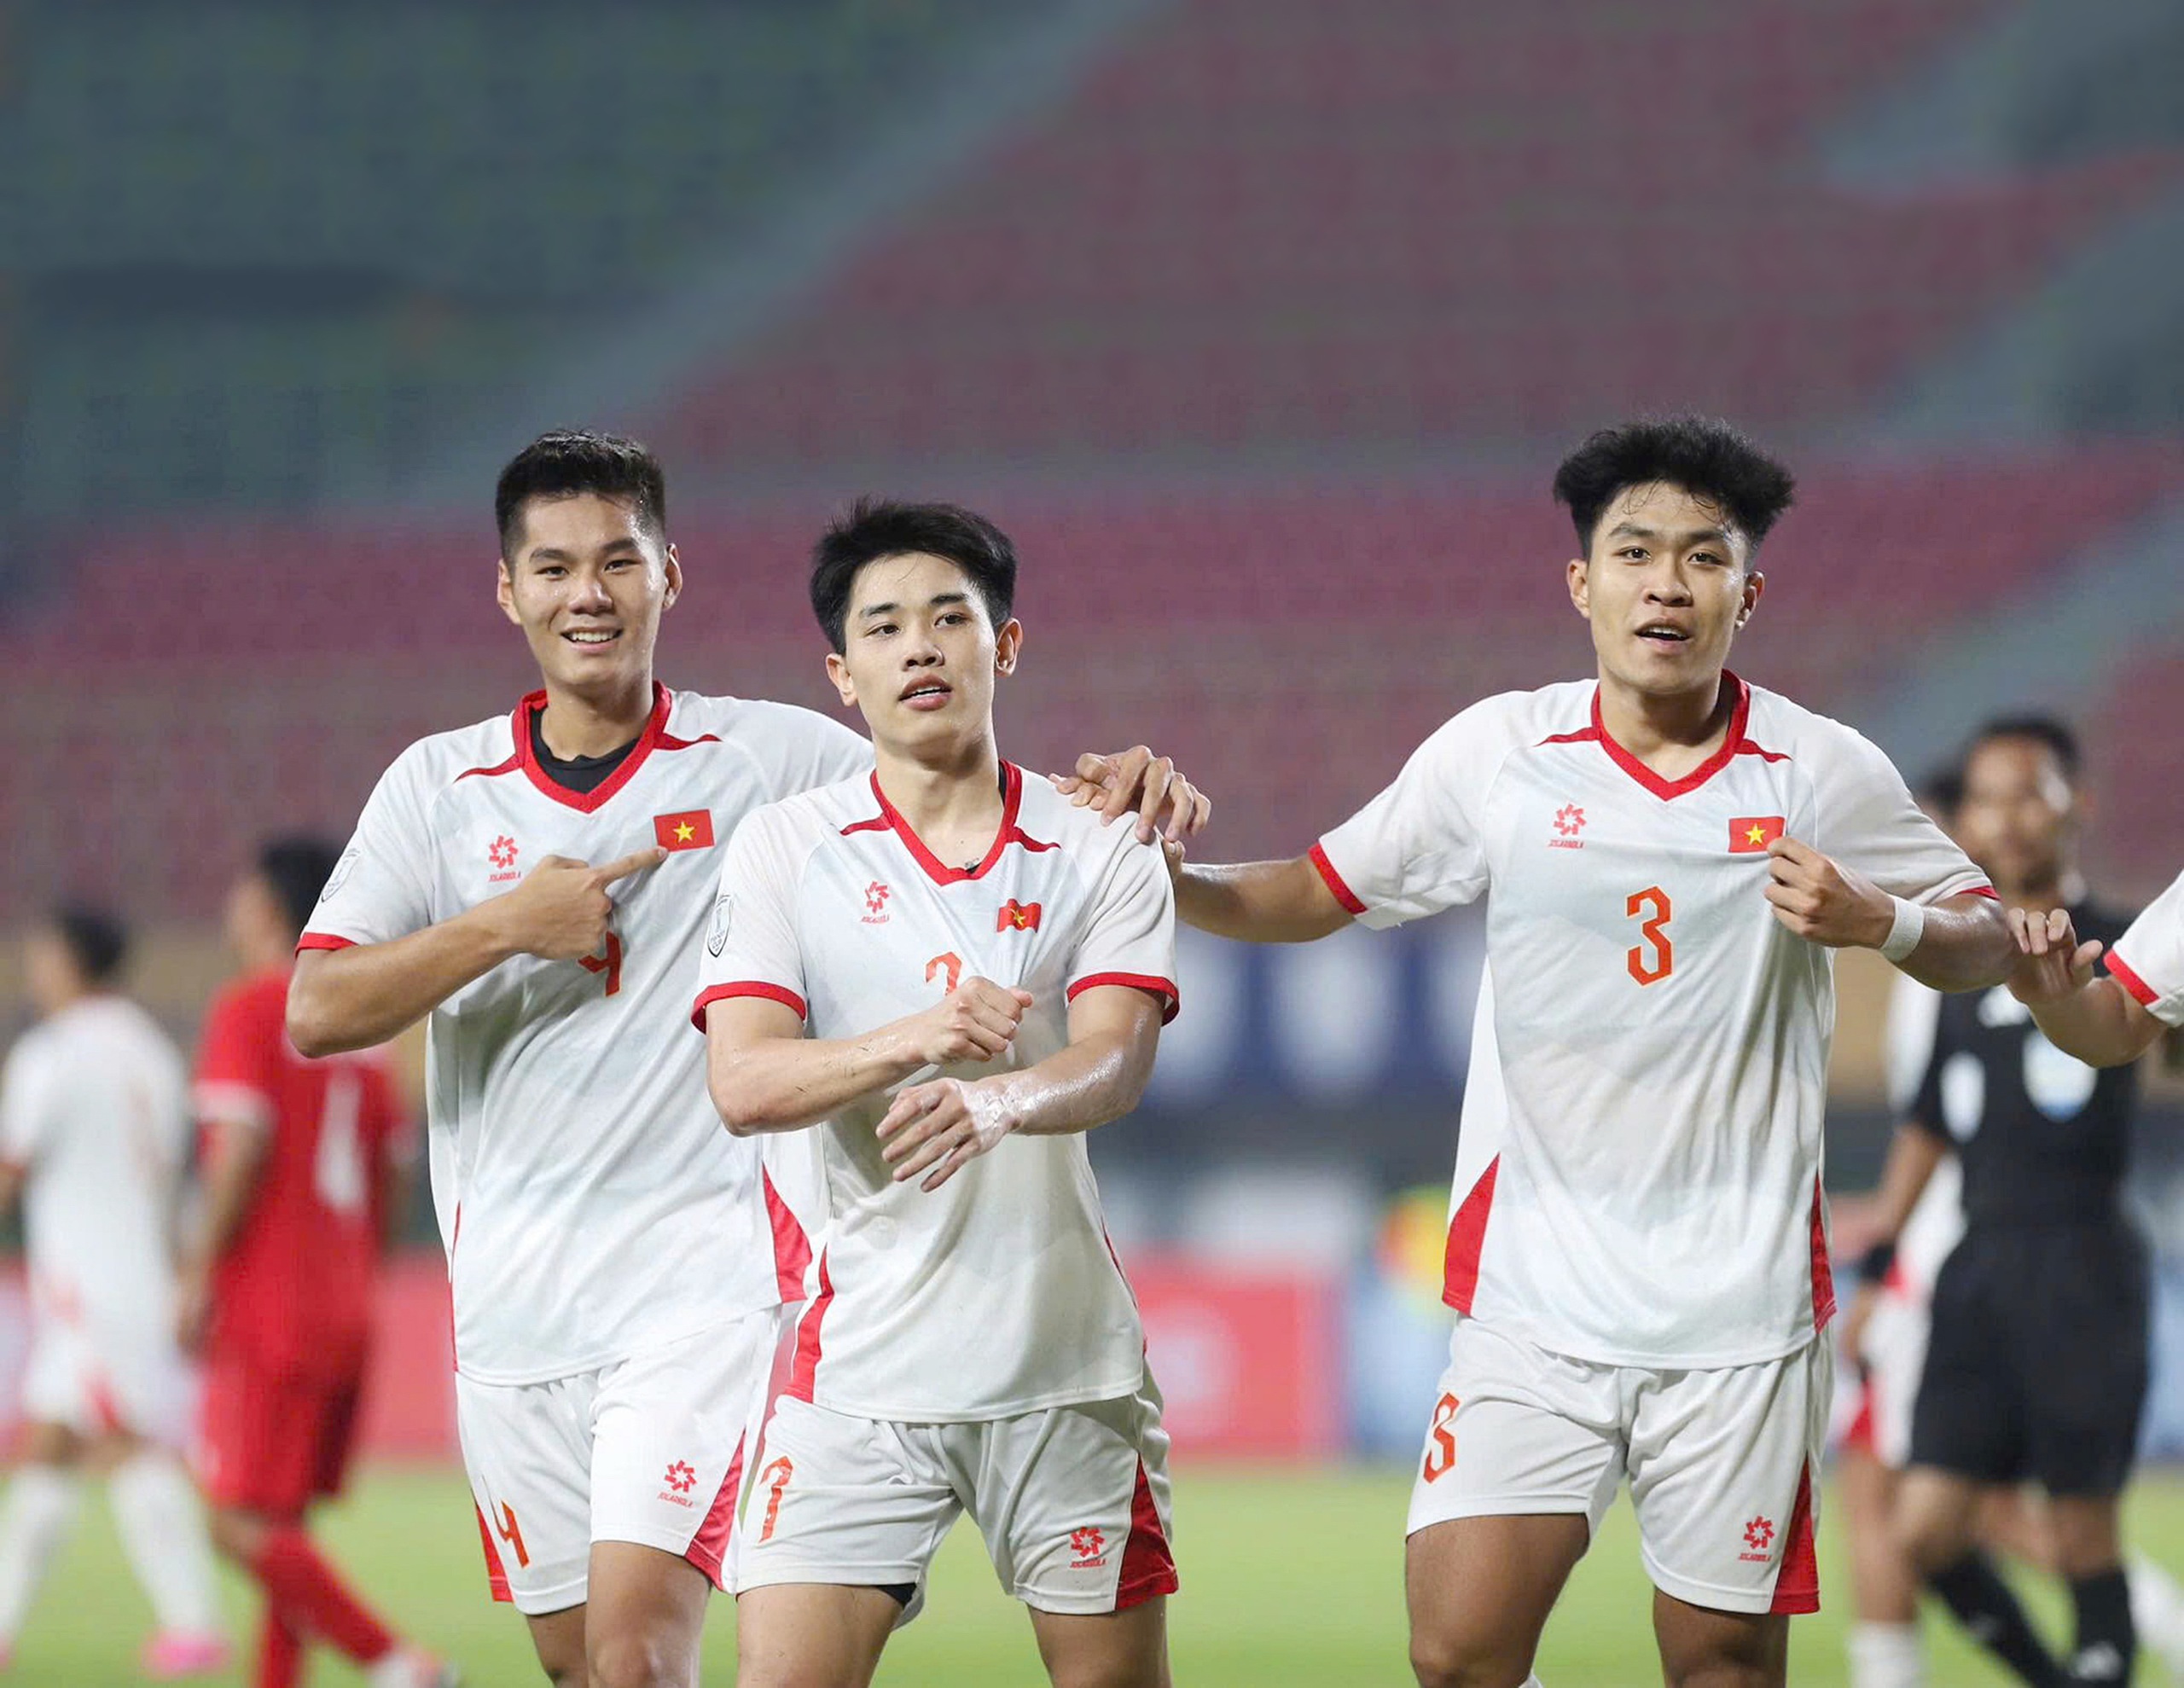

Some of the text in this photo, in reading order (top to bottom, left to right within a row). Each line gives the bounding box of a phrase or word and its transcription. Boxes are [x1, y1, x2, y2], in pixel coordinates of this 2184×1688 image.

[577, 930, 622, 998] 4
[1626, 885, 1673, 986] 3
[1423, 1391, 1461, 1484] 3
[481, 1475, 530, 1569] 4
